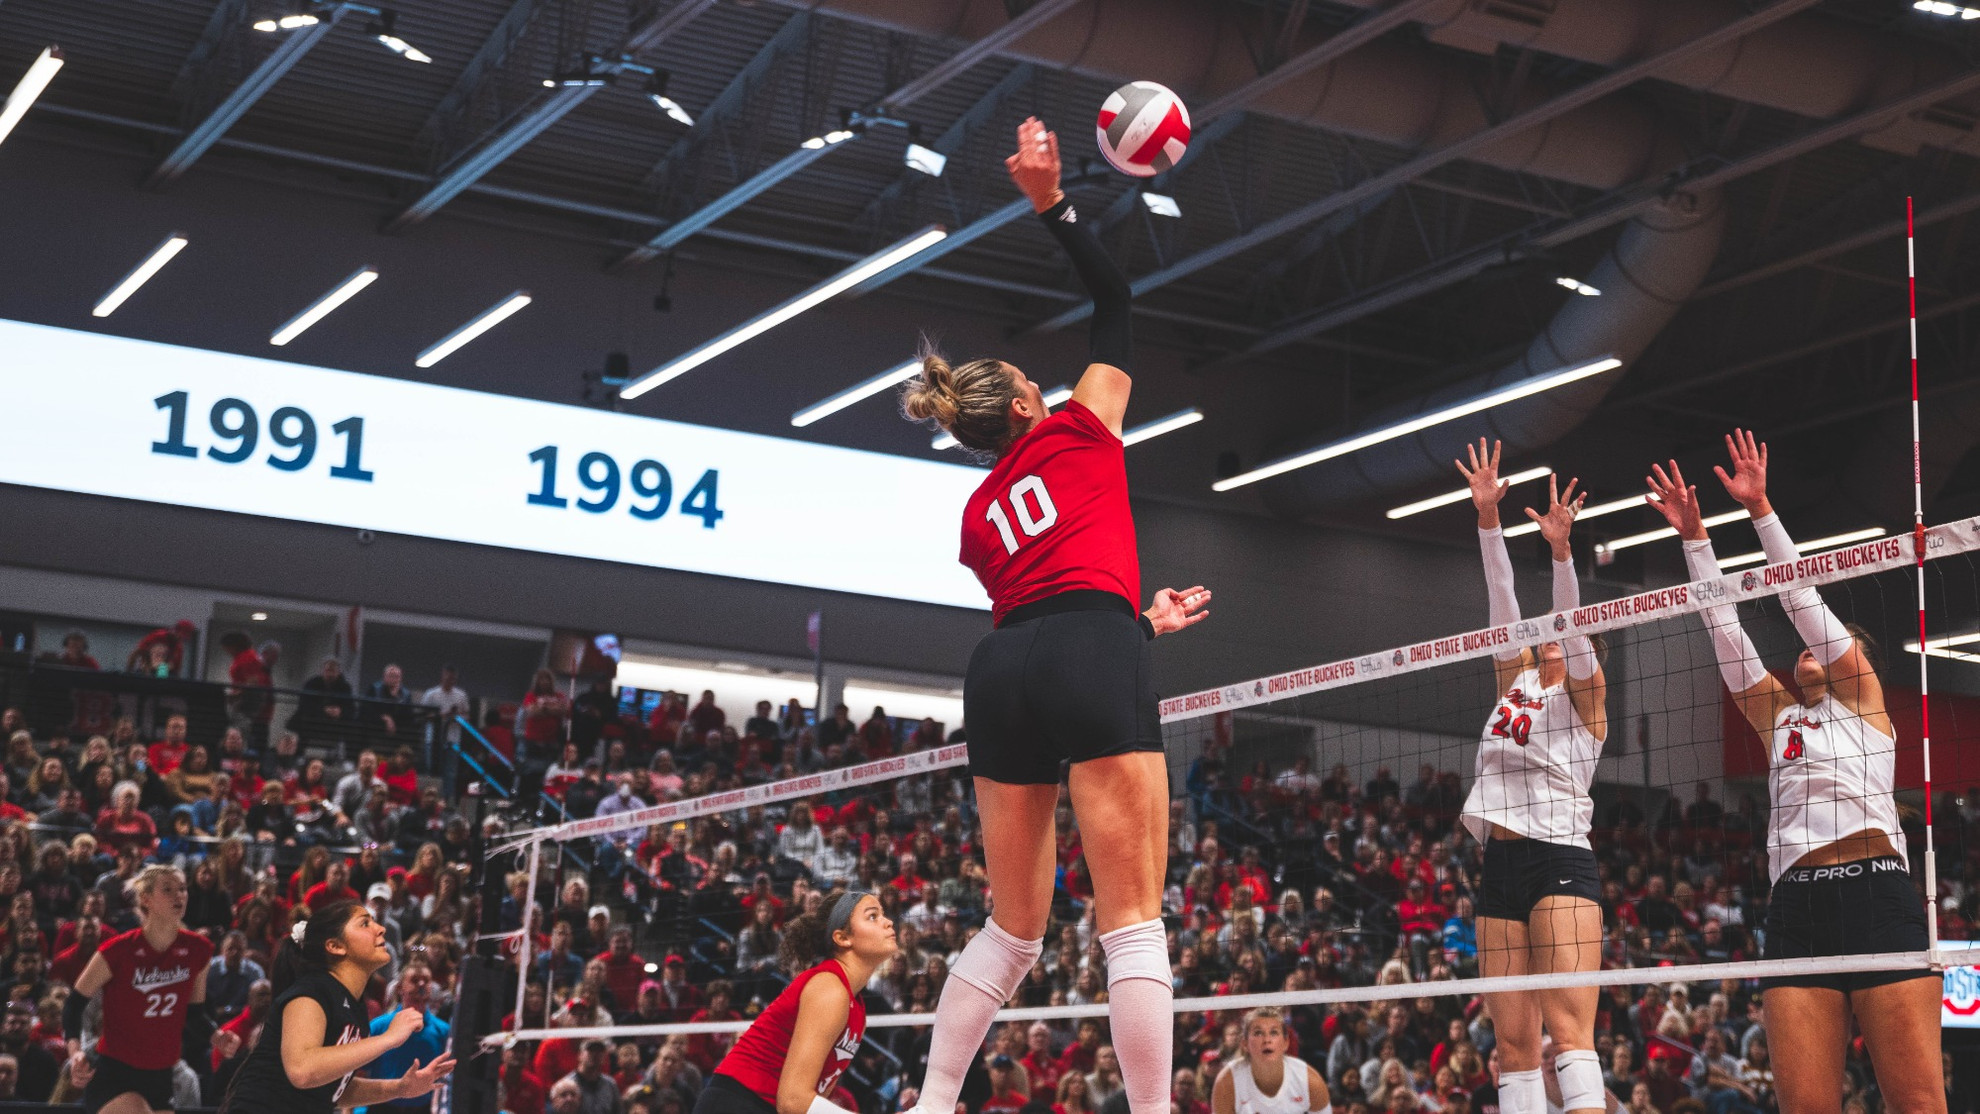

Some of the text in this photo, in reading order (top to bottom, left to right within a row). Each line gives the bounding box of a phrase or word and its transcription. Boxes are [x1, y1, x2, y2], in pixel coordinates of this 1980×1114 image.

[151, 390, 374, 483] 1991
[527, 445, 724, 530] 1994
[985, 473, 1060, 557] 10
[1764, 539, 1900, 586] OHIO STATE BUCKEYES
[1573, 586, 1688, 627] OHIO STATE BUCKEYES
[1696, 582, 1725, 601] Ohio
[1410, 627, 1509, 662] OHIO STATE BUCKEYES
[1515, 622, 1540, 639] Ohio
[1269, 661, 1355, 693] OHIO STATE BUCKEYES
[1163, 699, 1184, 716] STATE
[1185, 690, 1221, 711] BUCKEYES
[1491, 706, 1532, 746] 20
[1783, 730, 1804, 760] 8
[1781, 869, 1811, 882] IKE
[1813, 864, 1863, 881] PRO
[144, 993, 178, 1017] 22
